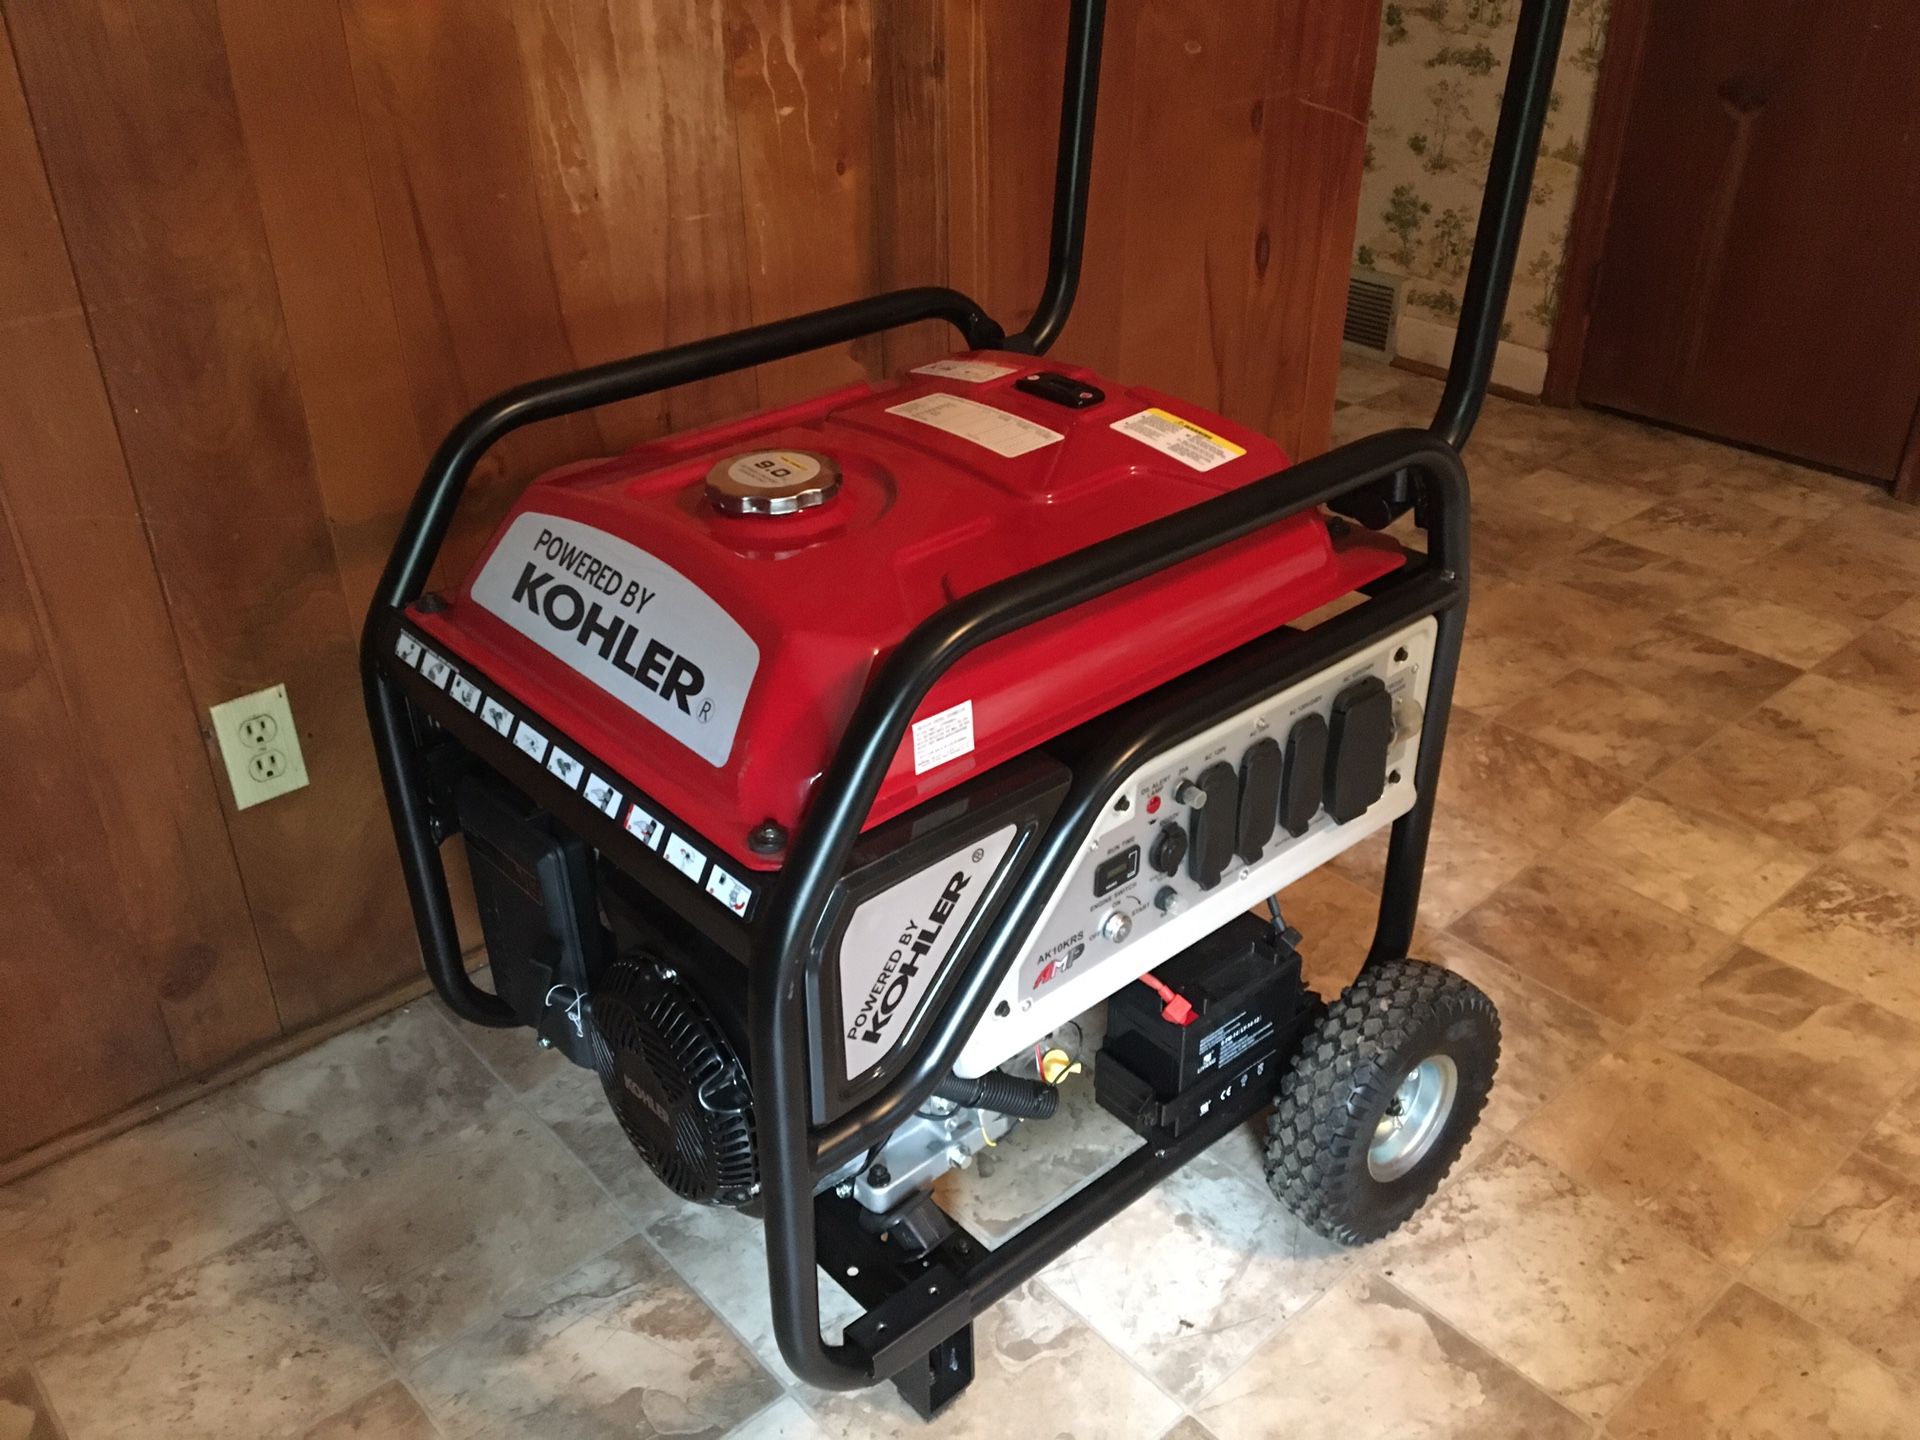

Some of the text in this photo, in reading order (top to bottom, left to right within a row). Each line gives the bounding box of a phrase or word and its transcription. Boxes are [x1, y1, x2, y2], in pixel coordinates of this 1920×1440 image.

[754, 460, 791, 477] 9.0
[533, 529, 656, 614] POWERED BY
[511, 561, 705, 716] KOHLER
[847, 919, 919, 1040] POWERED BY
[861, 870, 971, 1044] KOHLER
[1033, 943, 1085, 990] AMP
[1037, 930, 1084, 965] AK10KRS
